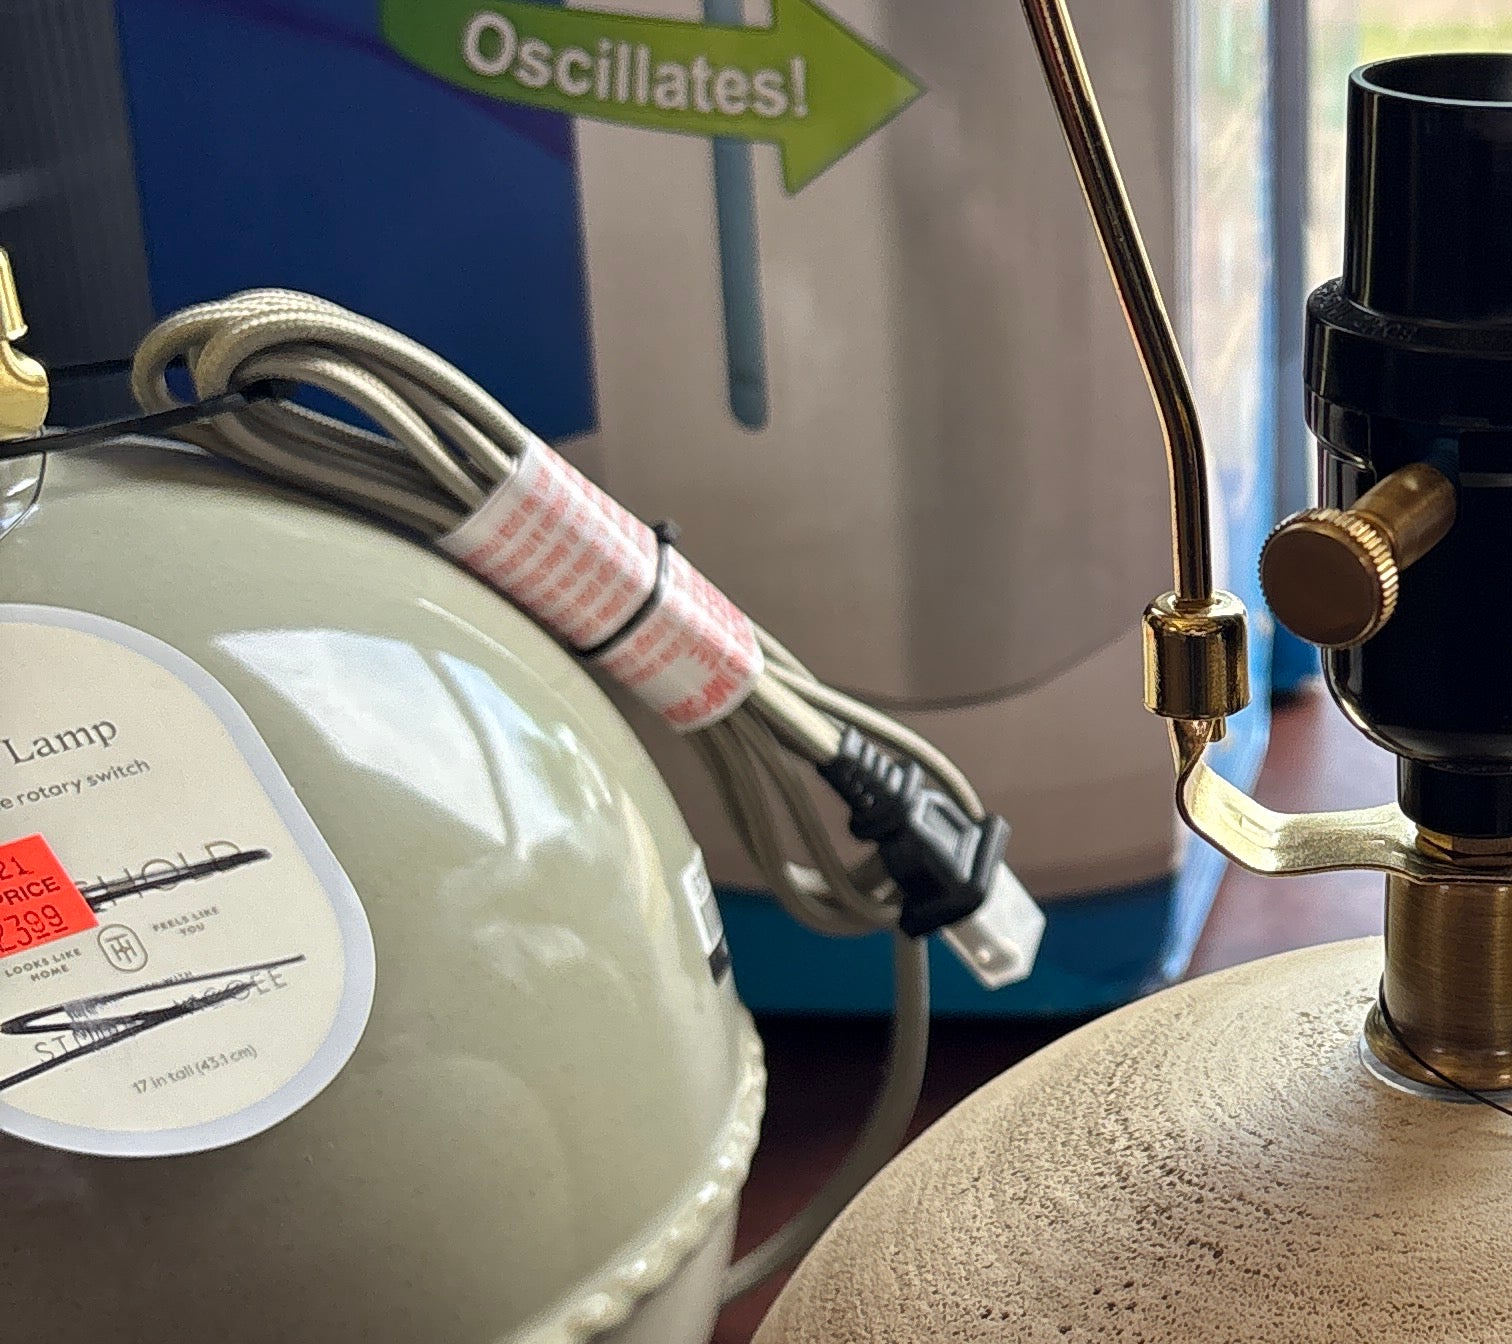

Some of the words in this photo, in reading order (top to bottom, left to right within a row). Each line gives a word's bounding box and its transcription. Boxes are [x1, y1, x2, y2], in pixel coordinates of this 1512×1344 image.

[462, 11, 809, 118] Oscillates!
[1, 720, 117, 765] Lamp
[16, 778, 82, 806] rotary
[86, 759, 151, 787] switch
[0, 876, 61, 906] RICE
[4, 957, 50, 978] LOOKS
[52, 948, 82, 963] LIKE
[30, 963, 70, 982] HOME
[132, 1079, 147, 1094] 17
[150, 1076, 168, 1089] in
[168, 1064, 195, 1082] tall
[230, 1044, 258, 1062] cm)
